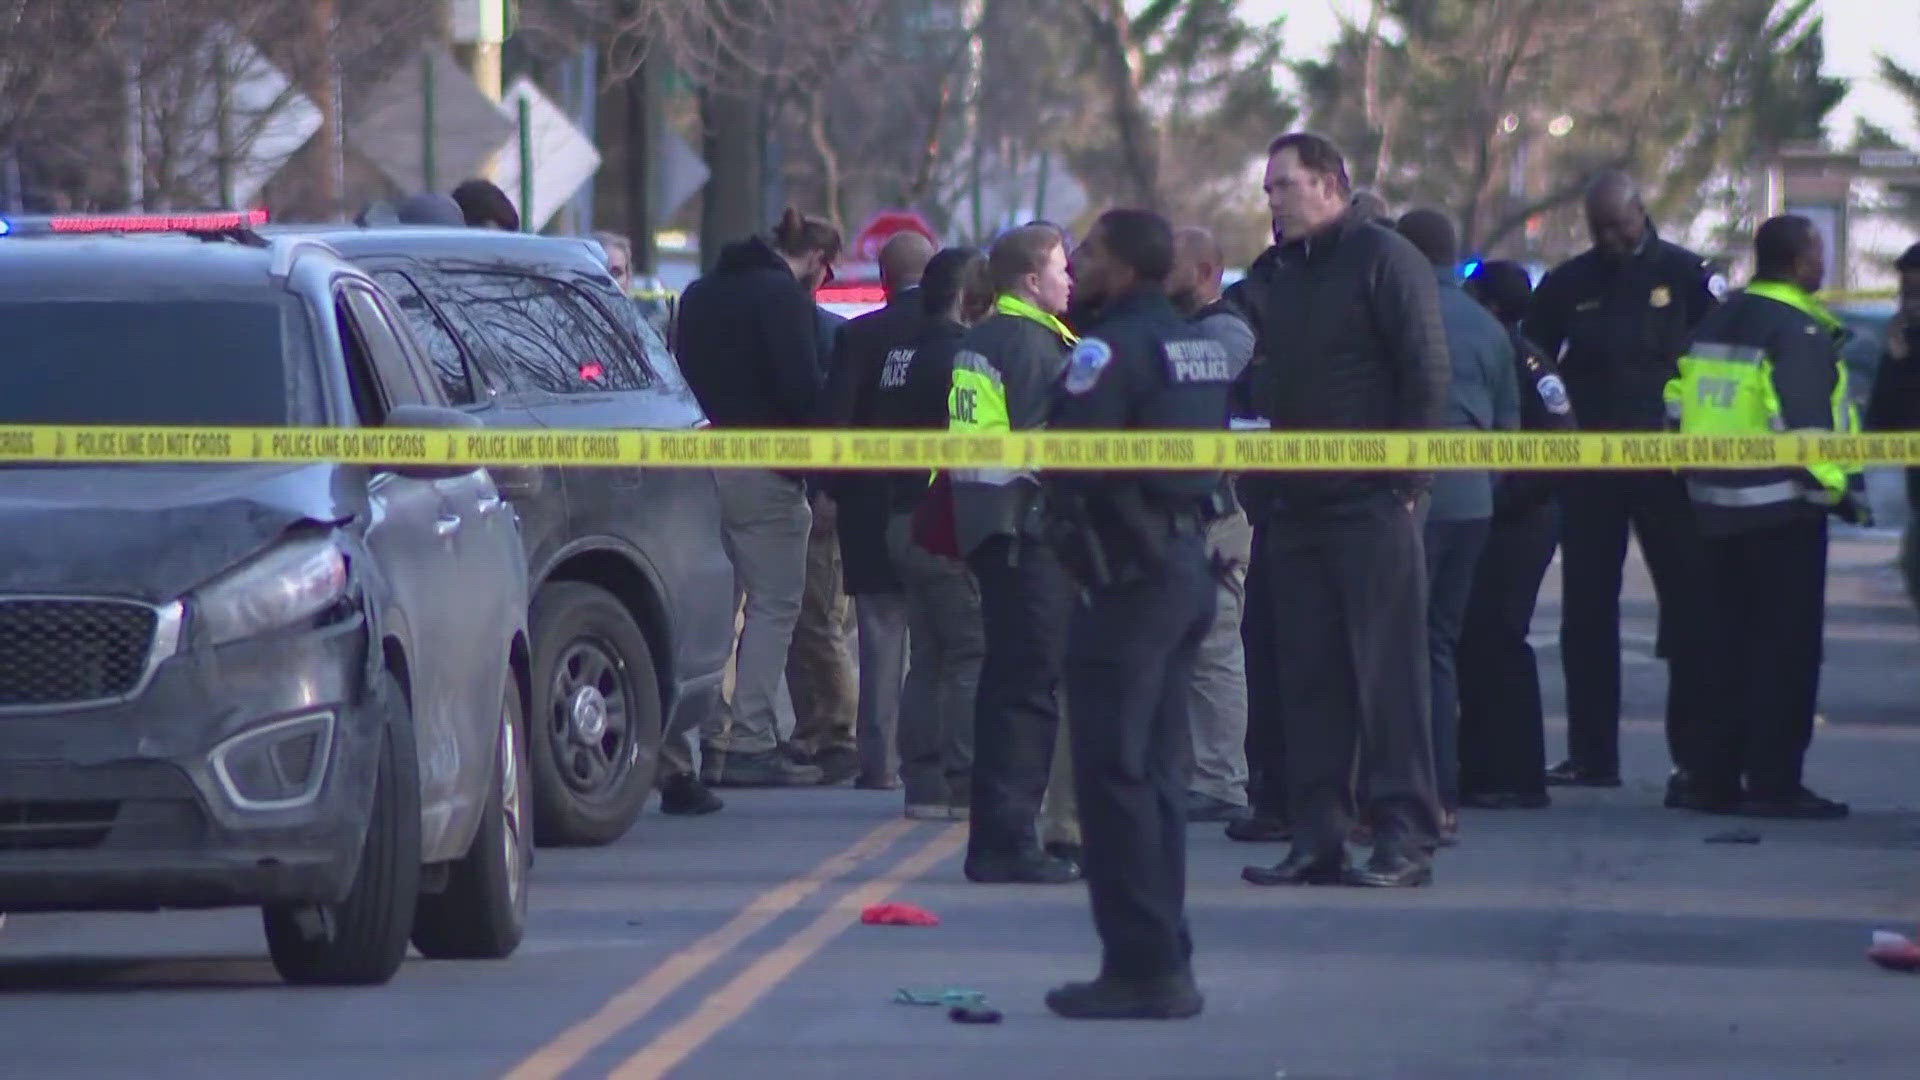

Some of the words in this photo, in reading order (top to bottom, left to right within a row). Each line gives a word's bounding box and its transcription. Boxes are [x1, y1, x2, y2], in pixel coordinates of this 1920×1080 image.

[1175, 359, 1231, 382] POLICE
[76, 433, 116, 455] POLICE
[120, 433, 144, 455] LINE
[146, 433, 164, 455] DO
[166, 433, 189, 455] NOT
[192, 433, 231, 455] CROSS
[272, 434, 312, 457] POLICE
[315, 434, 340, 457] LINE
[343, 434, 360, 457] DO
[362, 434, 386, 457] NOT
[388, 434, 426, 457] CROSS
[468, 436, 507, 458] POLICE
[510, 436, 535, 458] LINE
[538, 436, 554, 458] DO
[557, 436, 579, 458] NOT
[582, 436, 620, 458] CROSS
[1236, 439, 1273, 462] POLICE
[1277, 439, 1302, 462] LINE
[1305, 439, 1320, 462] DO
[1324, 439, 1345, 462] NOT
[1348, 439, 1386, 462] CROSS
[1428, 438, 1466, 462] POLICE
[1470, 438, 1494, 462] LINE
[1497, 438, 1513, 462] DO
[1517, 438, 1538, 462] NOT
[1542, 438, 1580, 462] CROSS
[1621, 438, 1662, 462] POLICE
[1664, 438, 1688, 462] LINE
[1692, 438, 1710, 462] DO
[1712, 438, 1734, 462] NOT
[1738, 438, 1776, 462] CROSS
